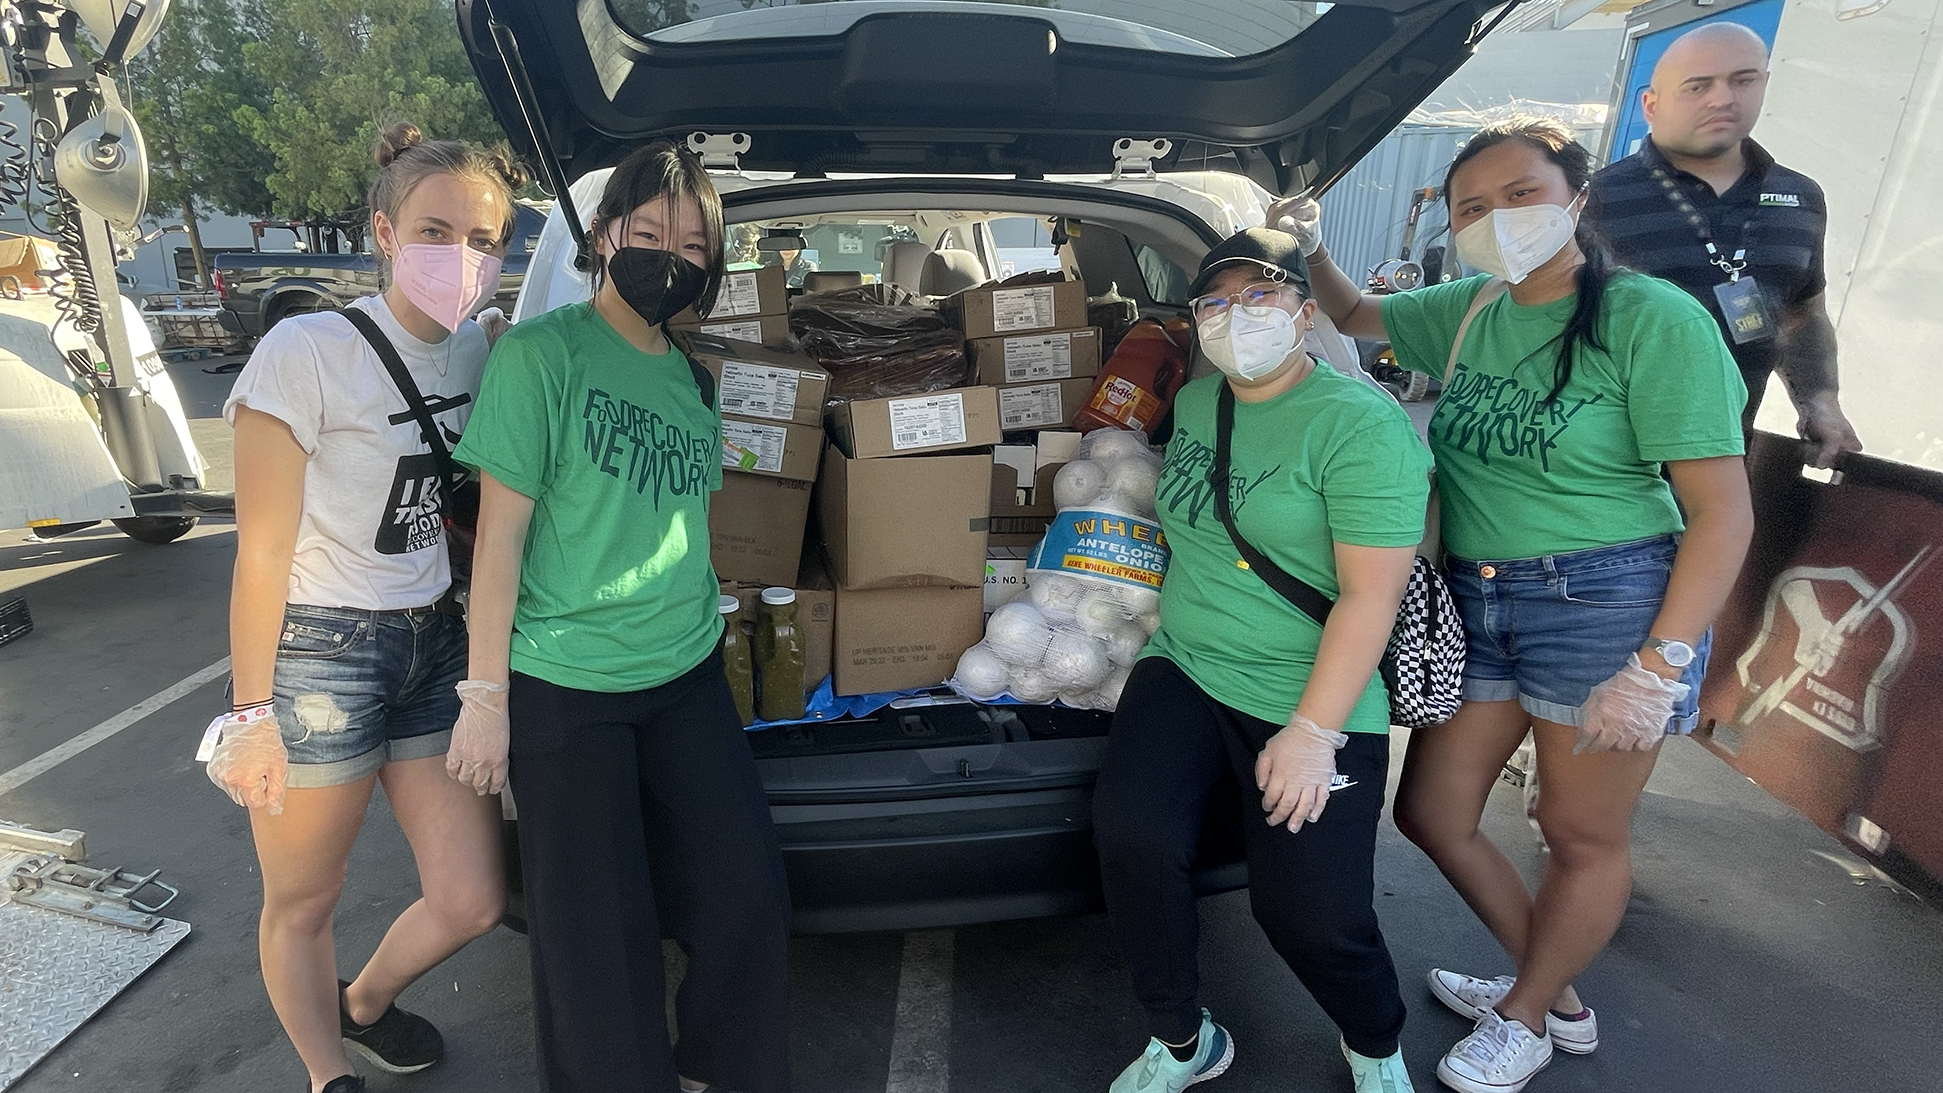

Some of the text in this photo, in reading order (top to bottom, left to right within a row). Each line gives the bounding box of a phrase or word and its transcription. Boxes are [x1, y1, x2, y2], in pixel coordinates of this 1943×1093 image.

[1429, 392, 1568, 472] ETWORK
[584, 420, 711, 512] NETWORK
[1077, 538, 1164, 565] ANTELOPE
[1002, 576, 1018, 585] NO.
[1084, 562, 1122, 577] WHEELER
